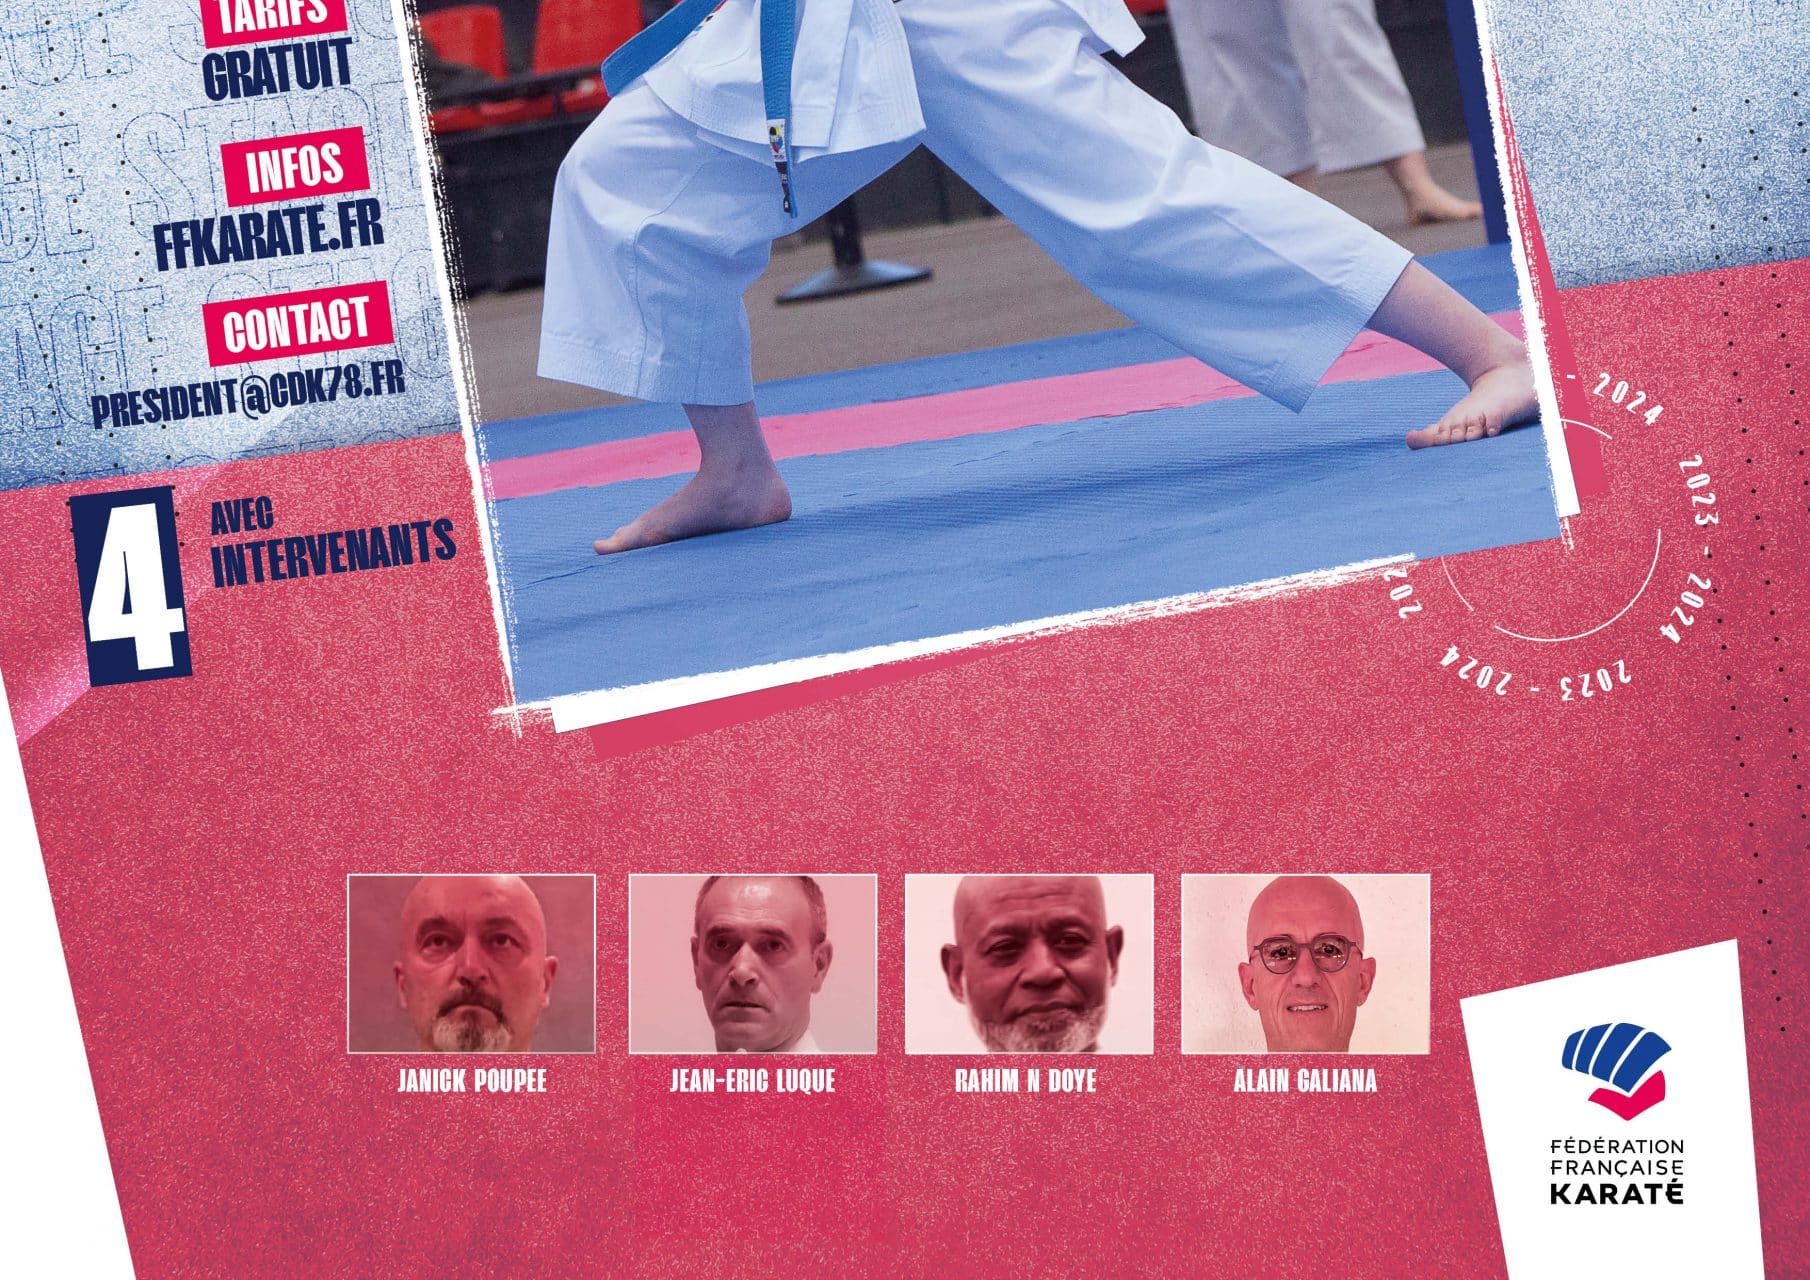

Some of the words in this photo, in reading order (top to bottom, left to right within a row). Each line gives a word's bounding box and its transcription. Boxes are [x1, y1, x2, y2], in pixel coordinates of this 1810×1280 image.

[202, 37, 353, 102] GRATUIT
[246, 142, 344, 193] INFOS
[153, 197, 385, 272] FFKARATE.FR
[223, 295, 369, 353] CONTACT
[90, 359, 406, 430] PRESIDENT@CDK78.FR
[1592, 372, 1665, 426] 2024
[211, 495, 274, 536] AVEC
[1678, 454, 1720, 526] 2023
[211, 518, 457, 588] INTERVENANTS
[88, 503, 185, 671] 4
[1659, 572, 1712, 644] 2024
[1440, 645, 1512, 696] 2024
[1560, 659, 1632, 701] 2023
[397, 1068, 466, 1093] JANICK
[474, 1068, 547, 1093] POUPEE
[669, 1068, 769, 1093] JEAN-ERIC
[776, 1068, 836, 1095] LUQUE
[955, 1068, 1019, 1093] RAHIM
[1027, 1068, 1040, 1093] N
[1048, 1068, 1097, 1093] DOYE
[1233, 1068, 1289, 1093] ALAIN
[1297, 1068, 1378, 1093] GALIANA
[1550, 1136, 1684, 1154] FÉDÉRATION
[1550, 1159, 1684, 1177] FRANÇAISE
[1550, 1178, 1684, 1205] KARATÉ
